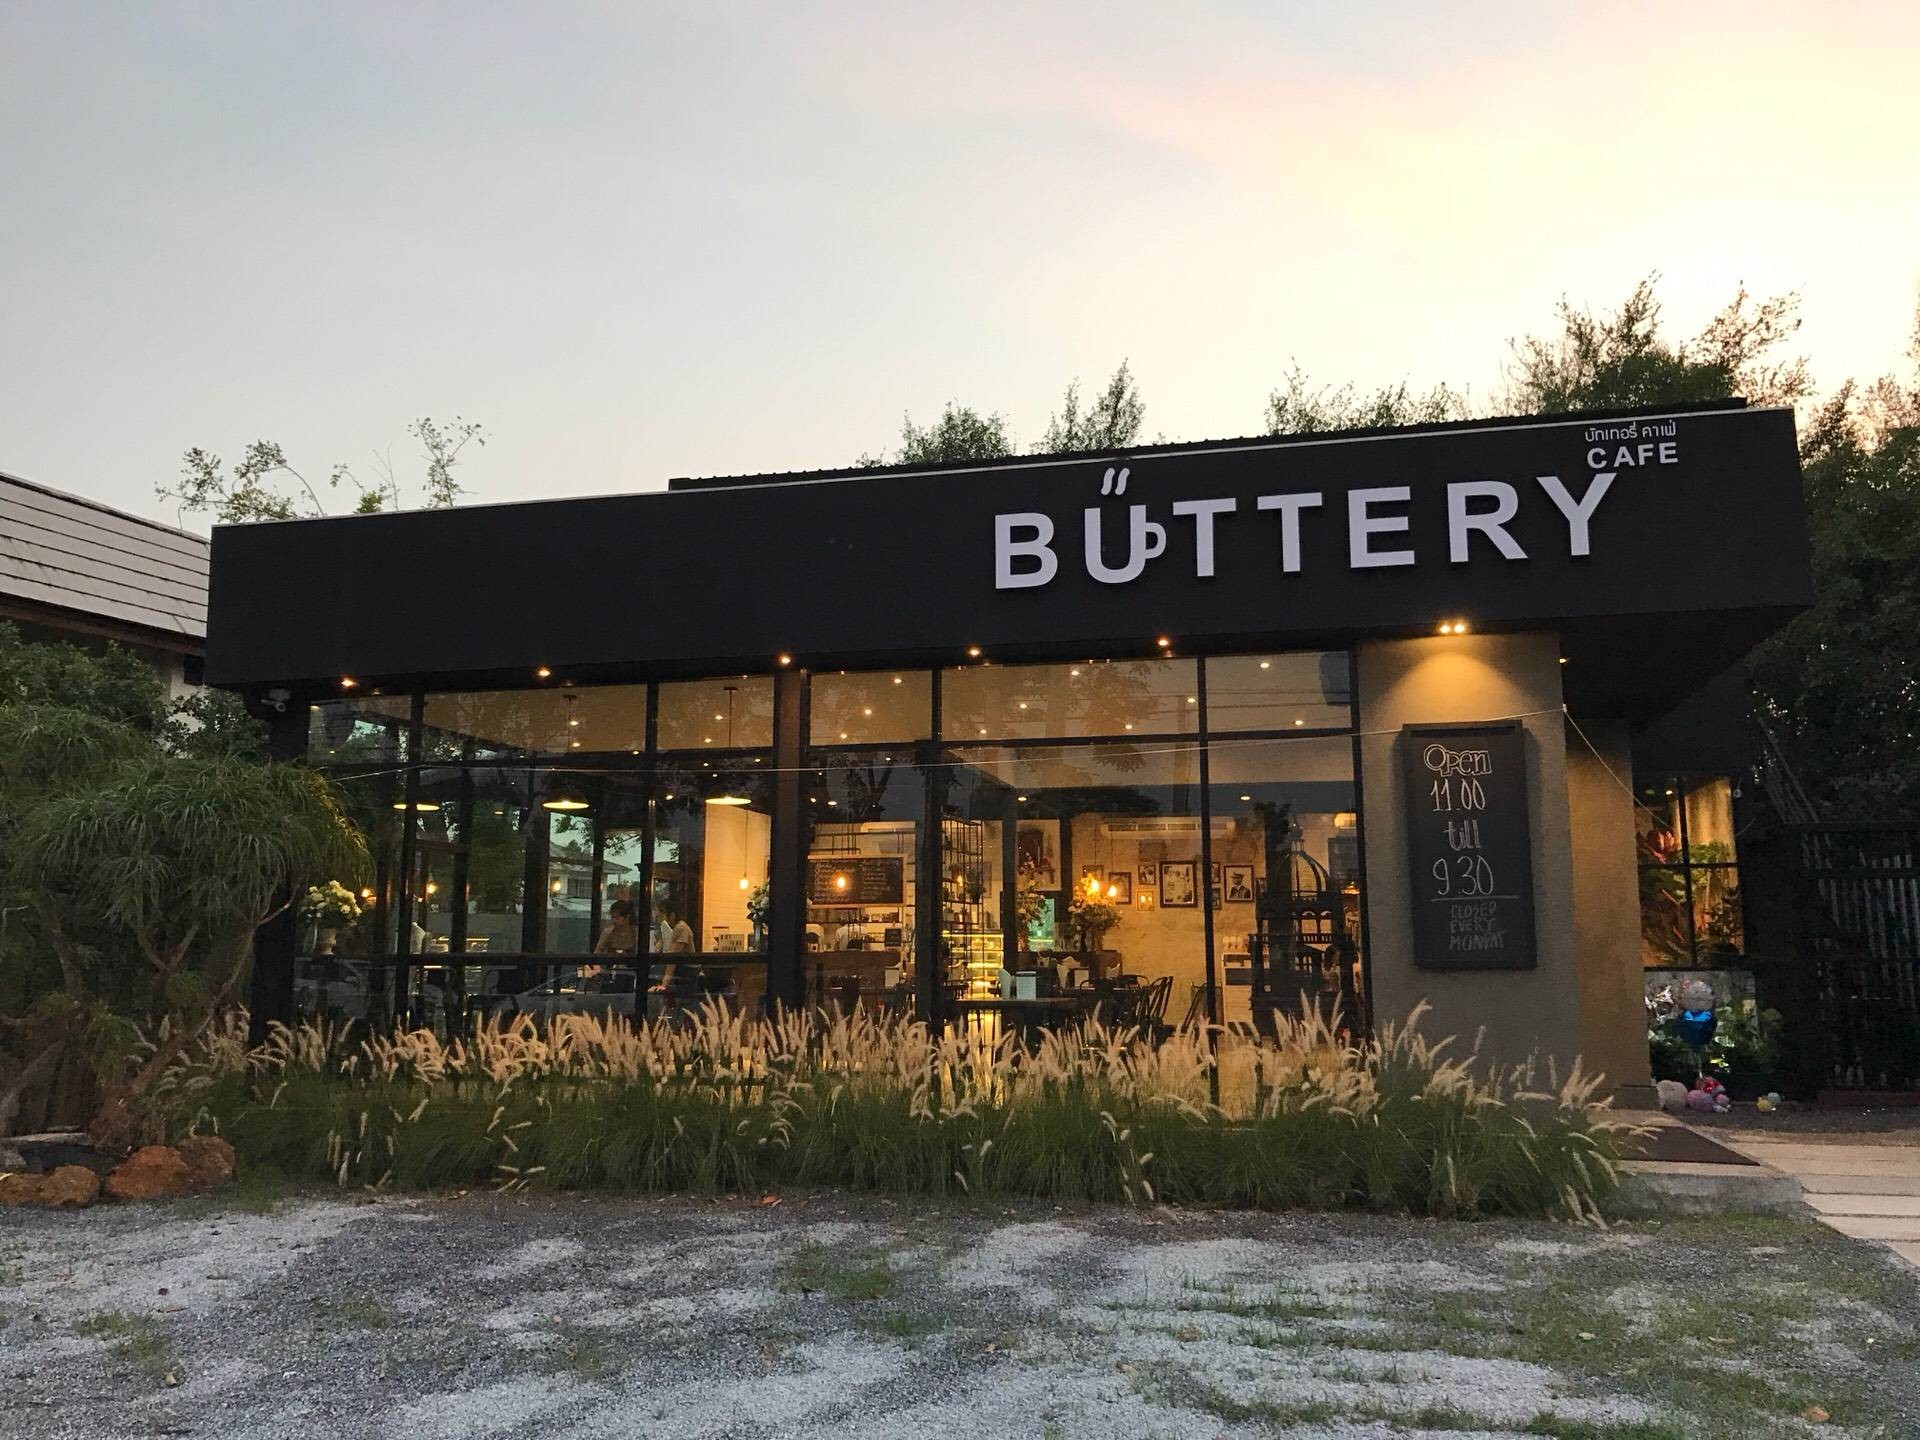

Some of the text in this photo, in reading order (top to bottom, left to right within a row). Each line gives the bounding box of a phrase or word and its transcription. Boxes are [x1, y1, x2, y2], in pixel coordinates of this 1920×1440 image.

[1642, 420, 1676, 438] คาเฟ่
[1587, 442, 1678, 469] CAFE
[995, 473, 1617, 589] BUTTERY
[1424, 744, 1492, 777] Open
[1443, 819, 1482, 851] till
[1451, 901, 1497, 919] CLOSED
[1450, 917, 1497, 934] EVERY
